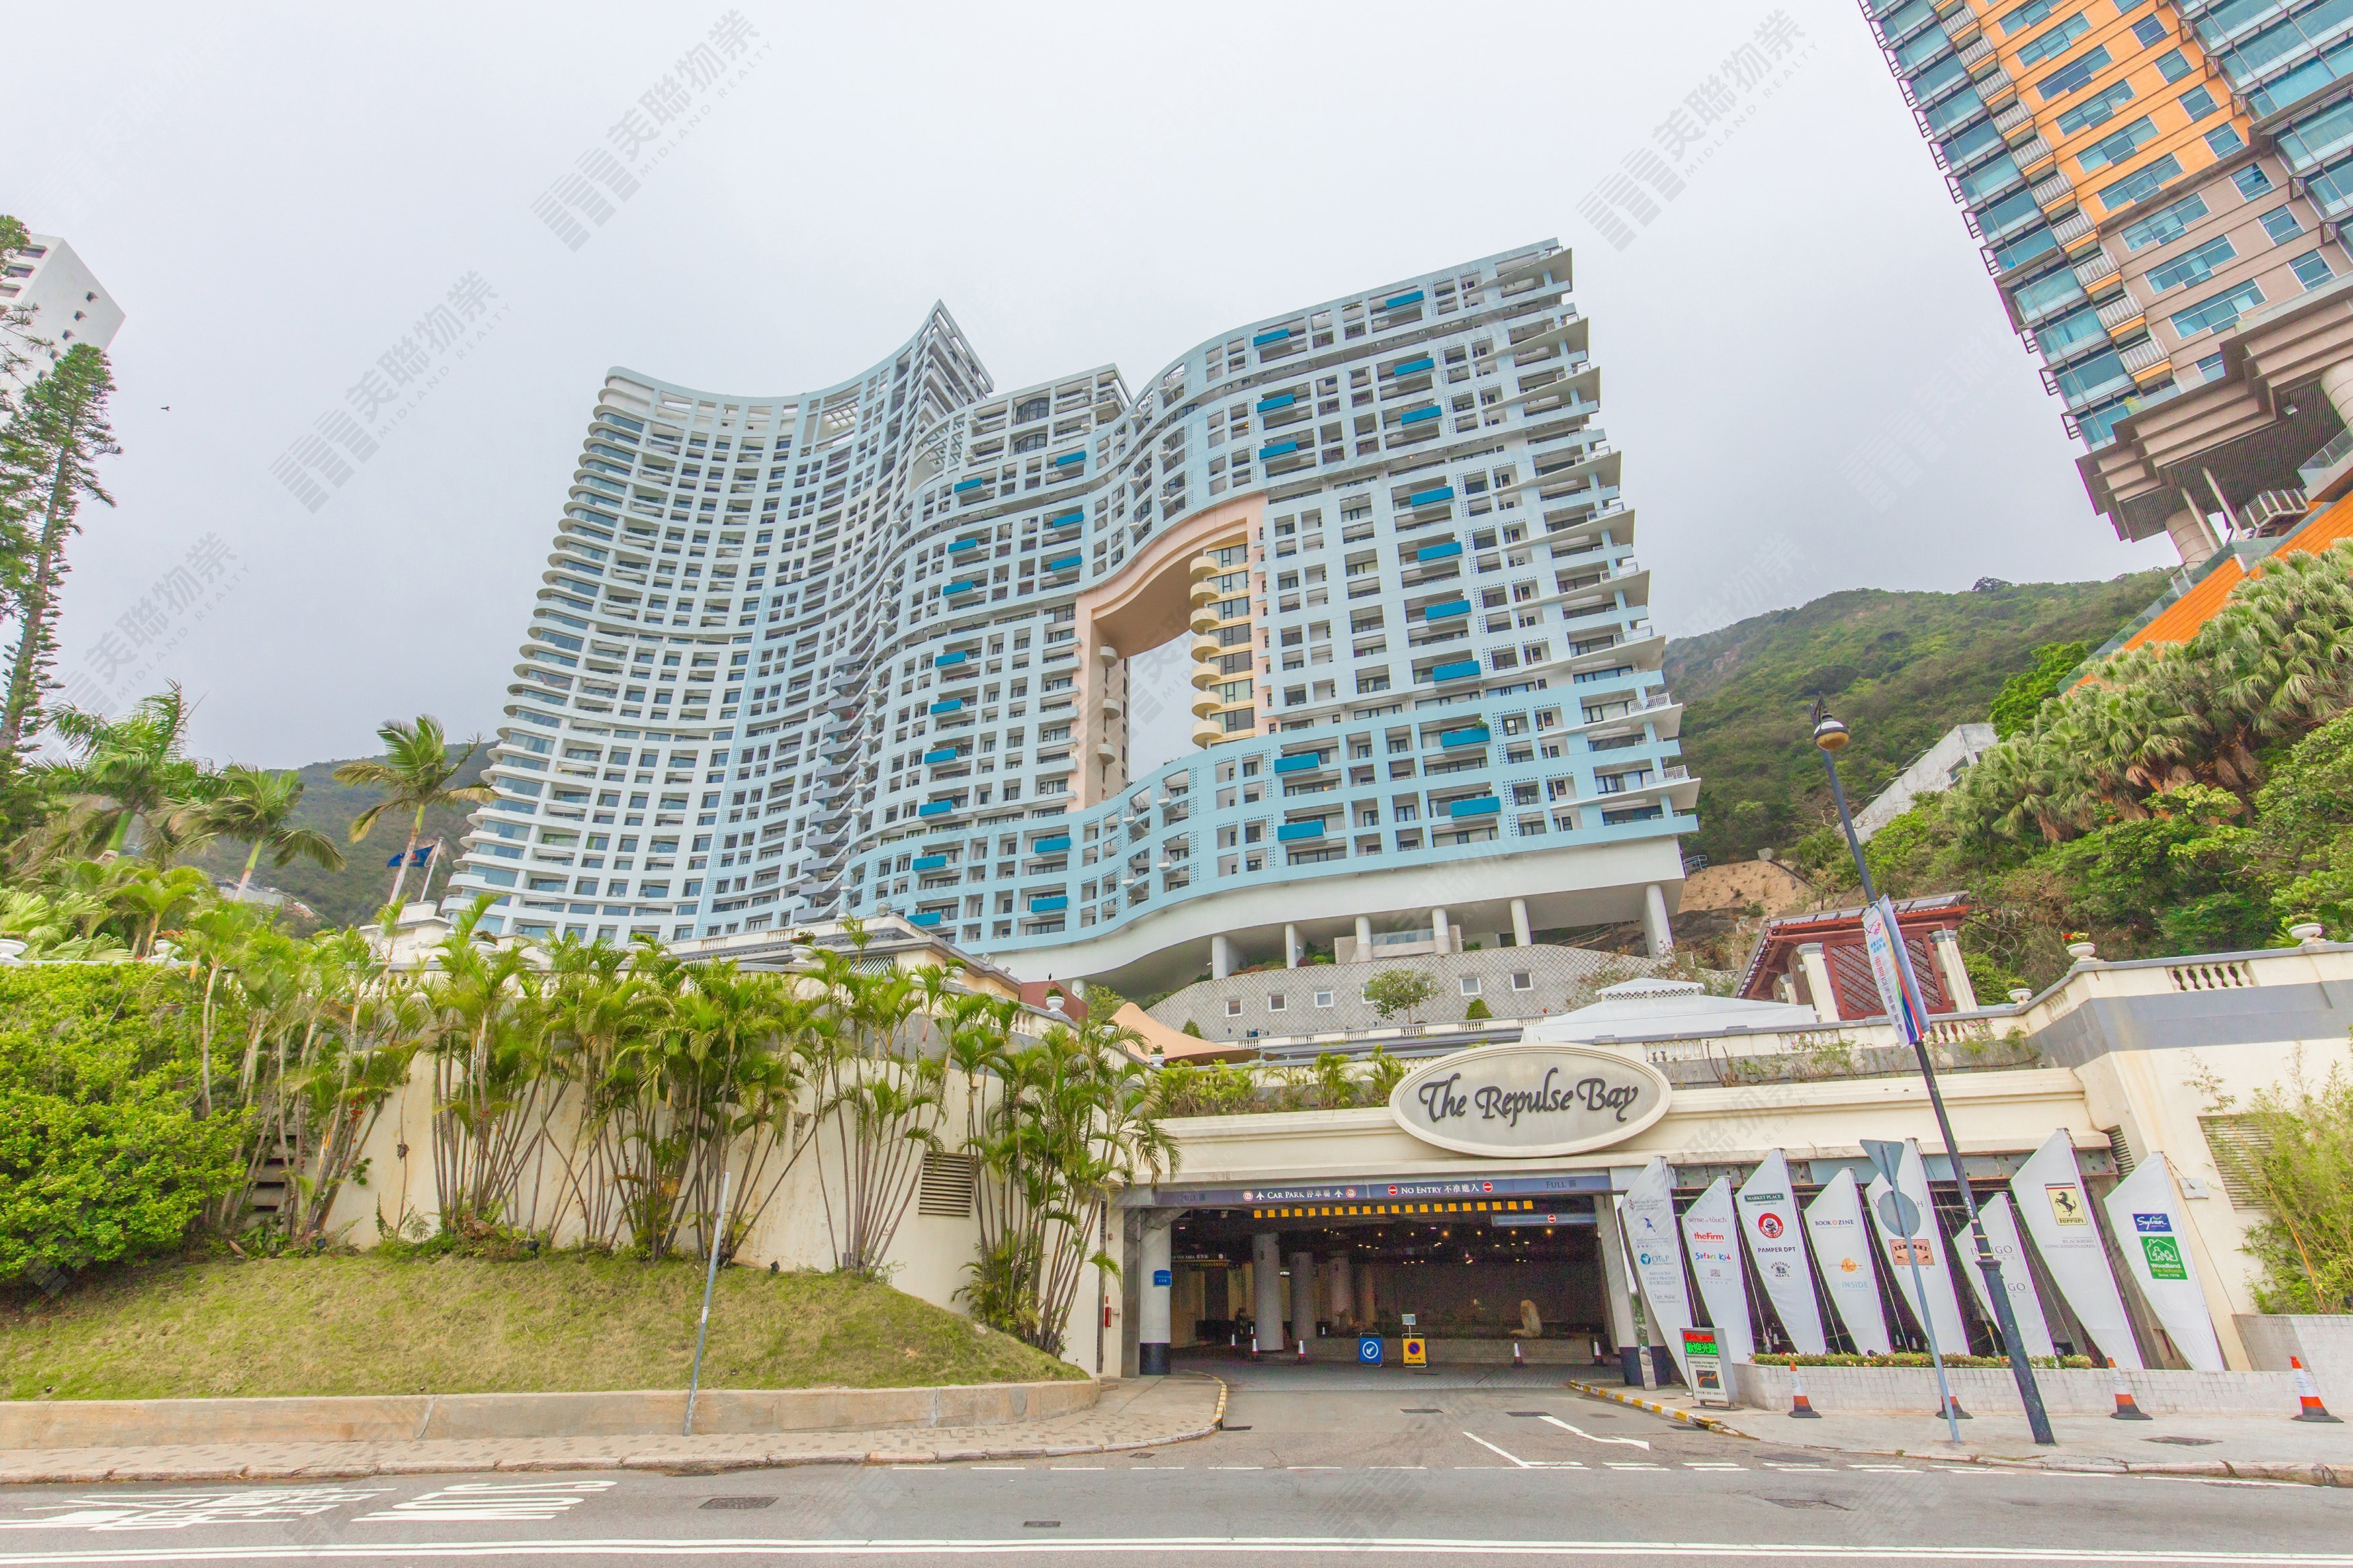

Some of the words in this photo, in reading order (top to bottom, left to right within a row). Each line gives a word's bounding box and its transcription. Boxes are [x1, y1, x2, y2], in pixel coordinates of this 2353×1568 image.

[1418, 1072, 1467, 1123] The
[1475, 1067, 1574, 1128] Repulse
[1576, 1077, 1639, 1123] Bay
[1267, 1191, 1283, 1199] CAR
[1306, 1189, 1330, 1198] 停車場
[1401, 1186, 1414, 1194] NO
[1416, 1186, 1442, 1194] ENTRY
[1444, 1184, 1480, 1193] 不准進入
[2137, 1216, 2168, 1231] Sylvan
[1694, 1231, 1725, 1240] theFirm
[1652, 1255, 1670, 1263] OT&P
[1695, 1252, 1716, 1260] Safari
[1719, 1253, 1731, 1261] Kid
[1770, 1261, 1791, 1269] HERITAGE
[350, 1481, 617, 1522] SLOW
